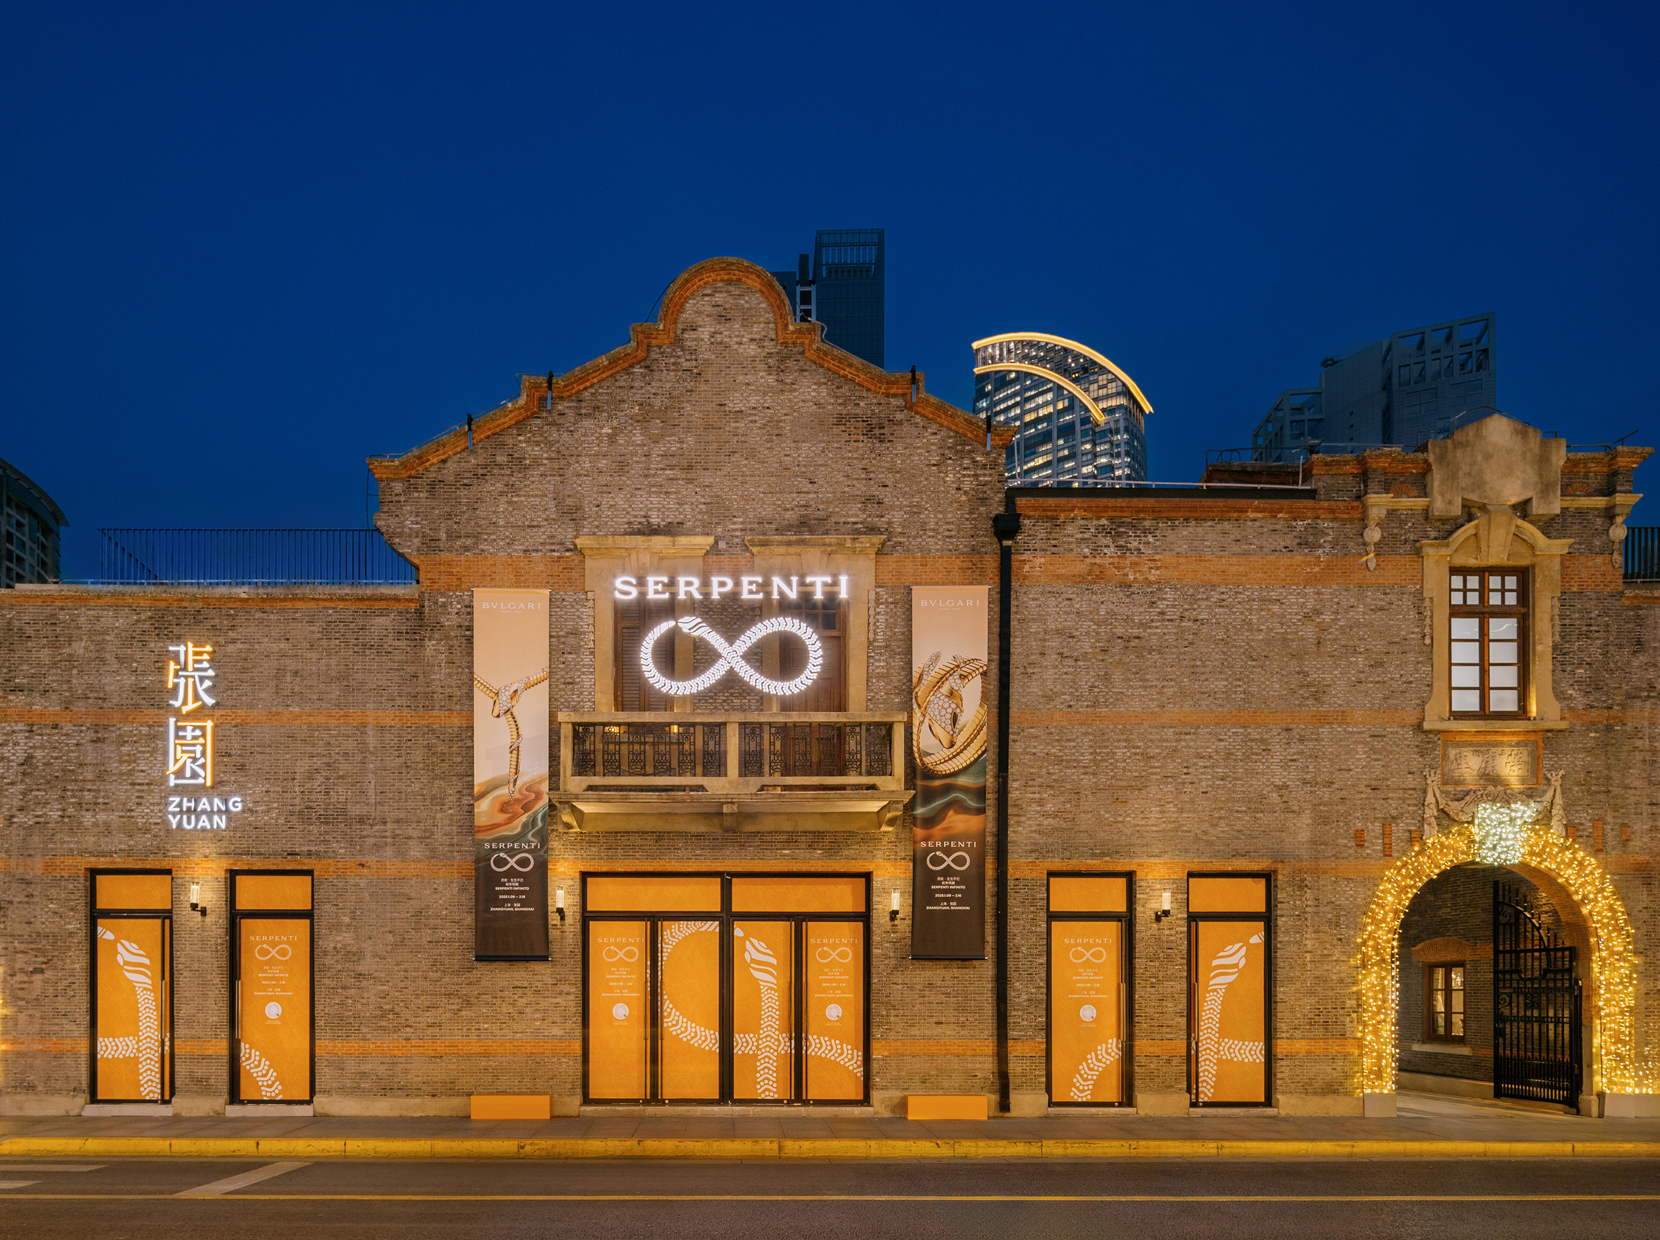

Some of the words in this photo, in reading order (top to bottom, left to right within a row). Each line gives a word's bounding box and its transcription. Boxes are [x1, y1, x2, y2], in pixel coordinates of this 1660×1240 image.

[614, 575, 849, 600] SERPENTI
[482, 602, 541, 610] BVLGARI
[166, 642, 216, 787] 張園
[168, 797, 243, 812] ZHANG
[168, 814, 226, 829] YUAN
